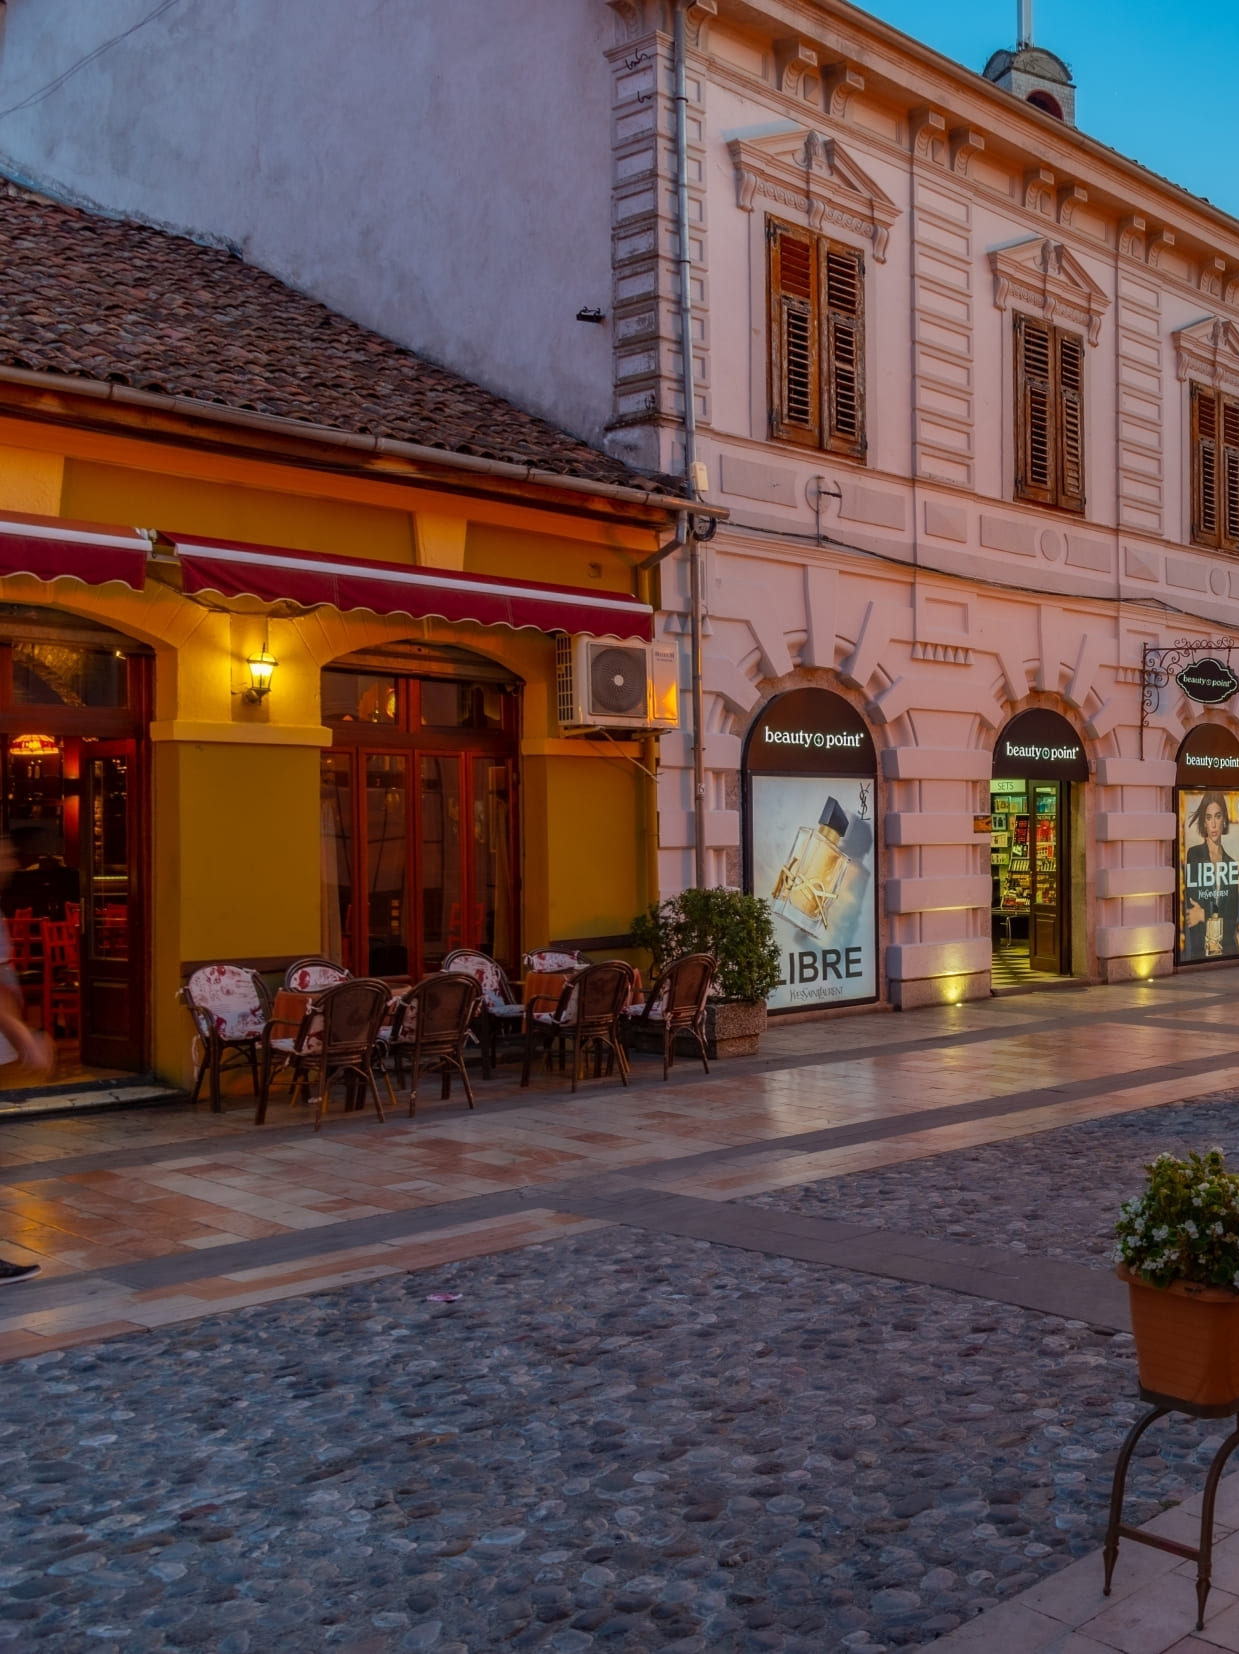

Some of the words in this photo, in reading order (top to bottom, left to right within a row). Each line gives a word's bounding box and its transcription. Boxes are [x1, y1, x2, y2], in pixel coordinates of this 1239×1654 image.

[1183, 675, 1206, 686] beauty
[764, 726, 813, 748] beauty
[826, 732, 861, 749] point
[1006, 741, 1042, 760] beauty
[1051, 746, 1077, 760] point
[1186, 753, 1214, 768] beauty
[997, 782, 1014, 791] SETS
[1186, 861, 1239, 888] LIBRE
